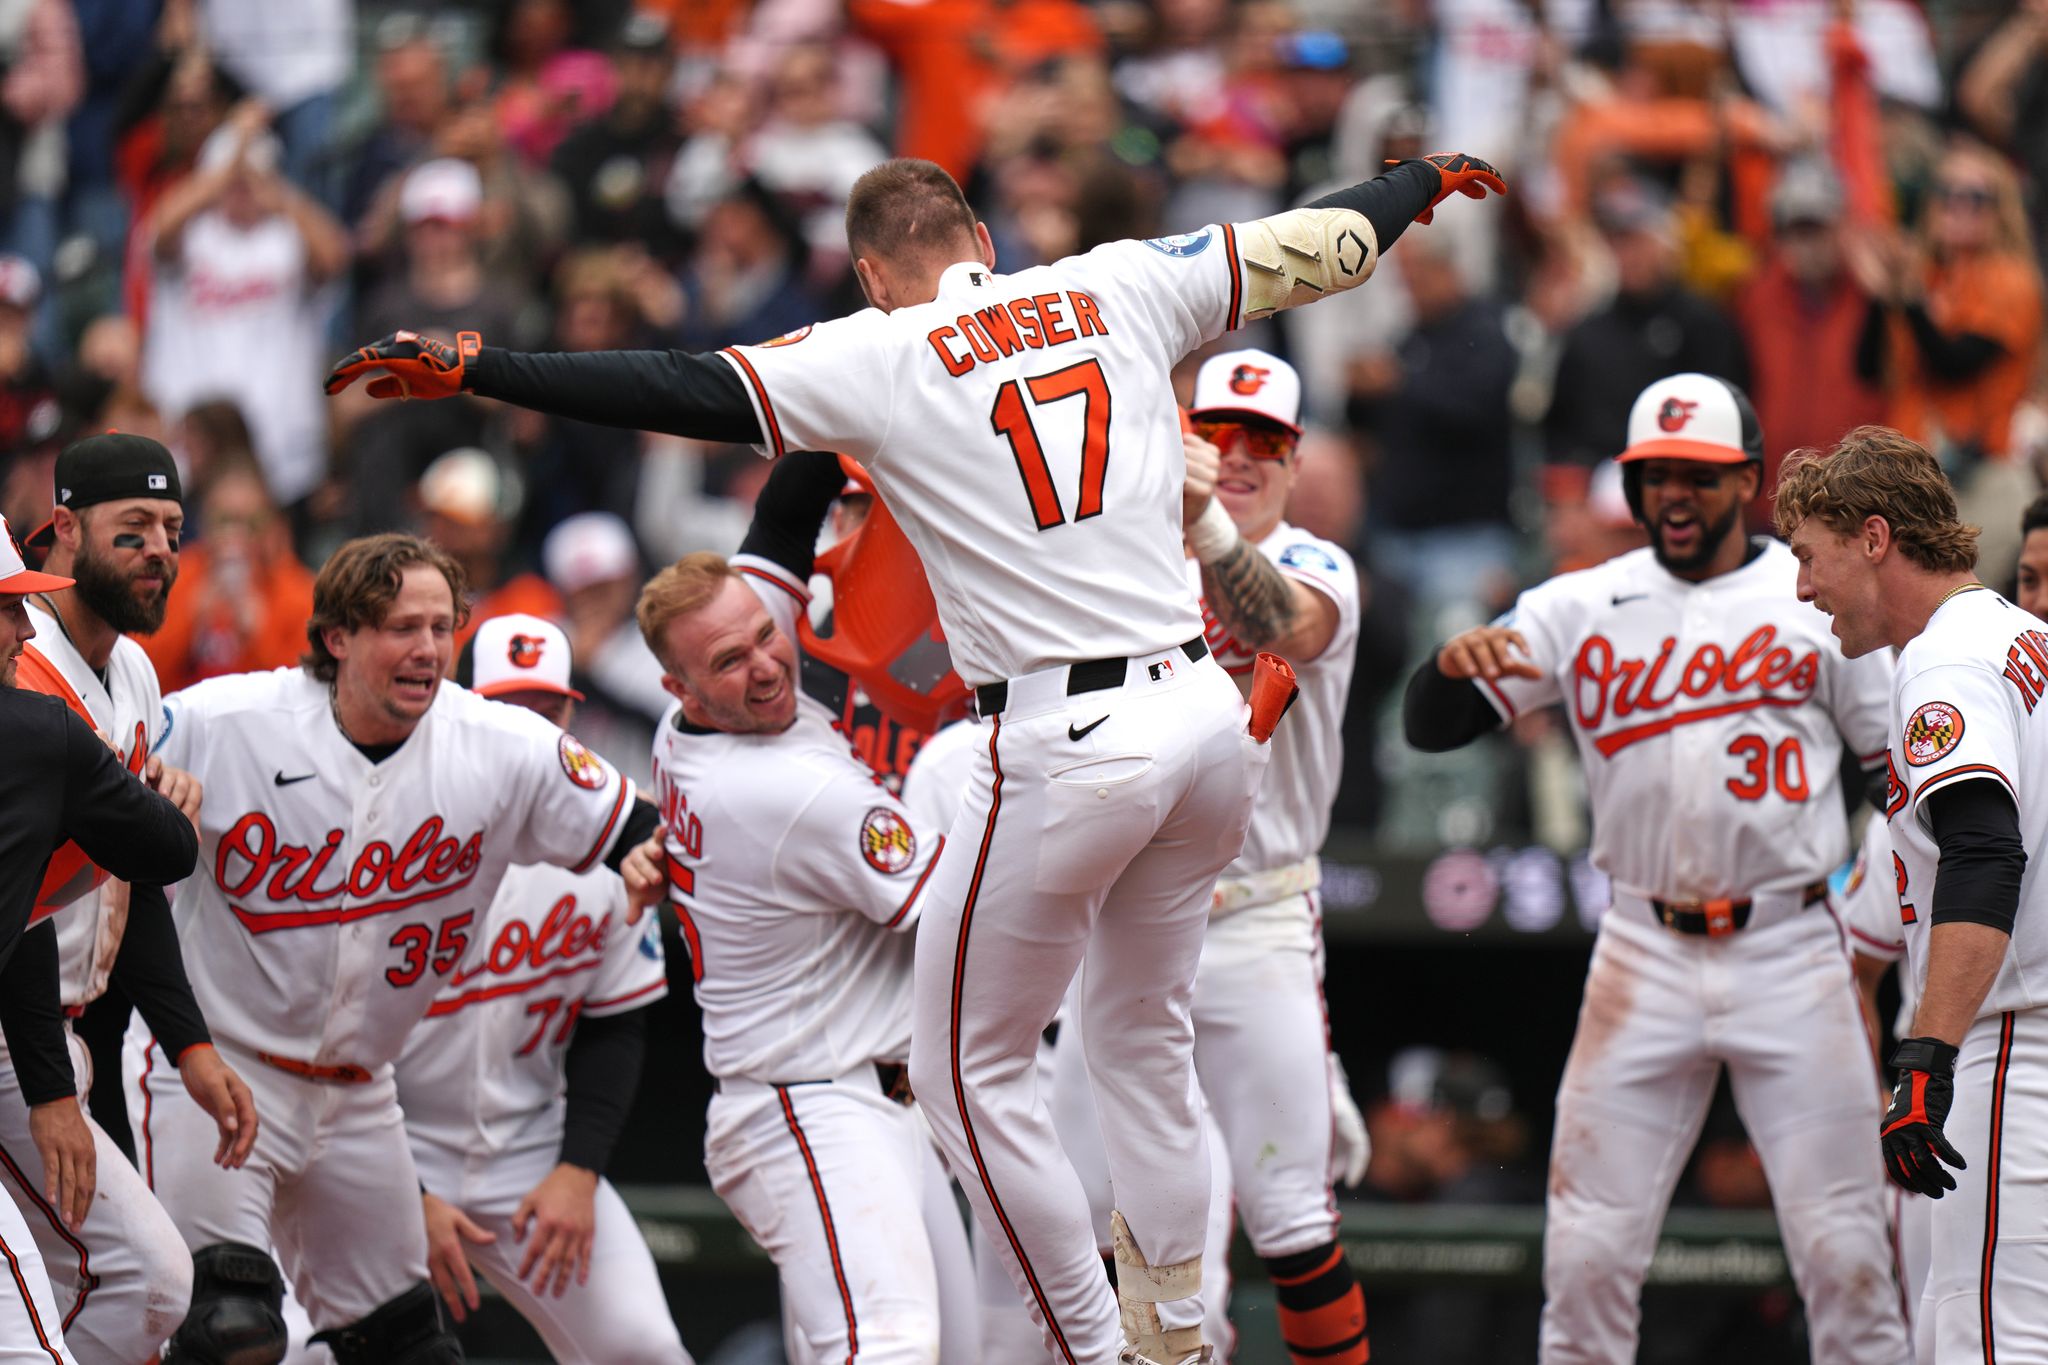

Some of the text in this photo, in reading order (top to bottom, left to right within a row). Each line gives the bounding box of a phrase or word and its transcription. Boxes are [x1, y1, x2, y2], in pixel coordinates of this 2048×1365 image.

[927, 290, 1109, 377] COWSER
[989, 356, 1112, 532] 17
[1575, 623, 1820, 760] Orioles
[1904, 703, 1955, 742] BALTIMORE
[852, 712, 930, 776] OLE
[1725, 733, 1810, 803] 30
[1914, 737, 1957, 763] ORIOLES
[215, 811, 483, 936] Orioles
[385, 908, 475, 988] 35
